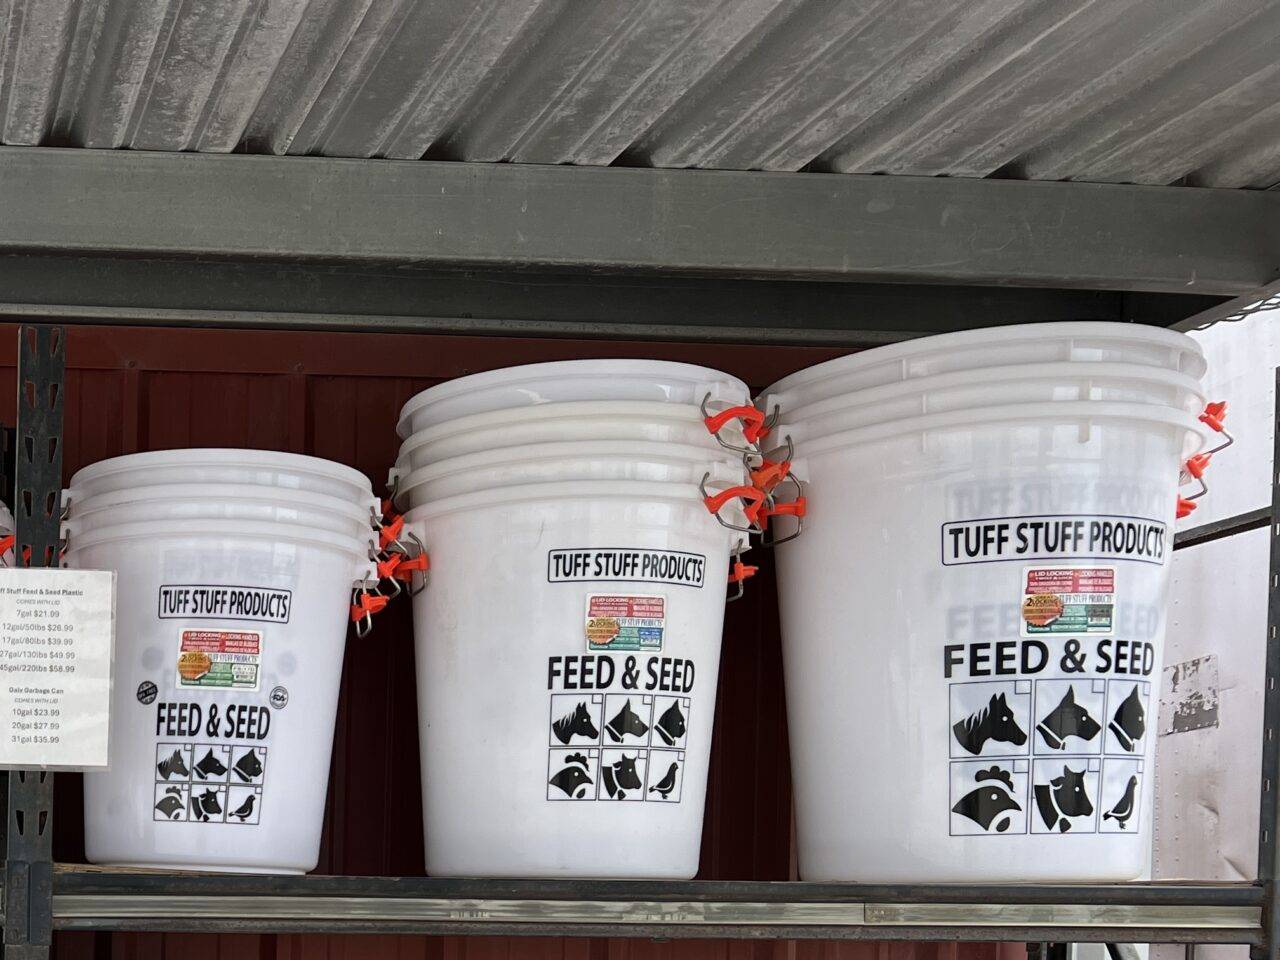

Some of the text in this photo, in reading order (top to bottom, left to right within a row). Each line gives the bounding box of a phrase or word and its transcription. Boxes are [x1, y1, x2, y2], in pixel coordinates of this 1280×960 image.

[949, 522, 1165, 558] TUFF STUFF PRODUCTS
[553, 553, 703, 583] TUFF STUFF PRODUCTS
[162, 589, 288, 619] TUFF STUFF PRODUCTS
[547, 656, 695, 693] FEED & SEED
[943, 639, 1154, 679] FEED & SEED
[11, 721, 32, 730] 20gal
[12, 708, 32, 717] 10gal
[156, 703, 270, 740] FEED & SEED
